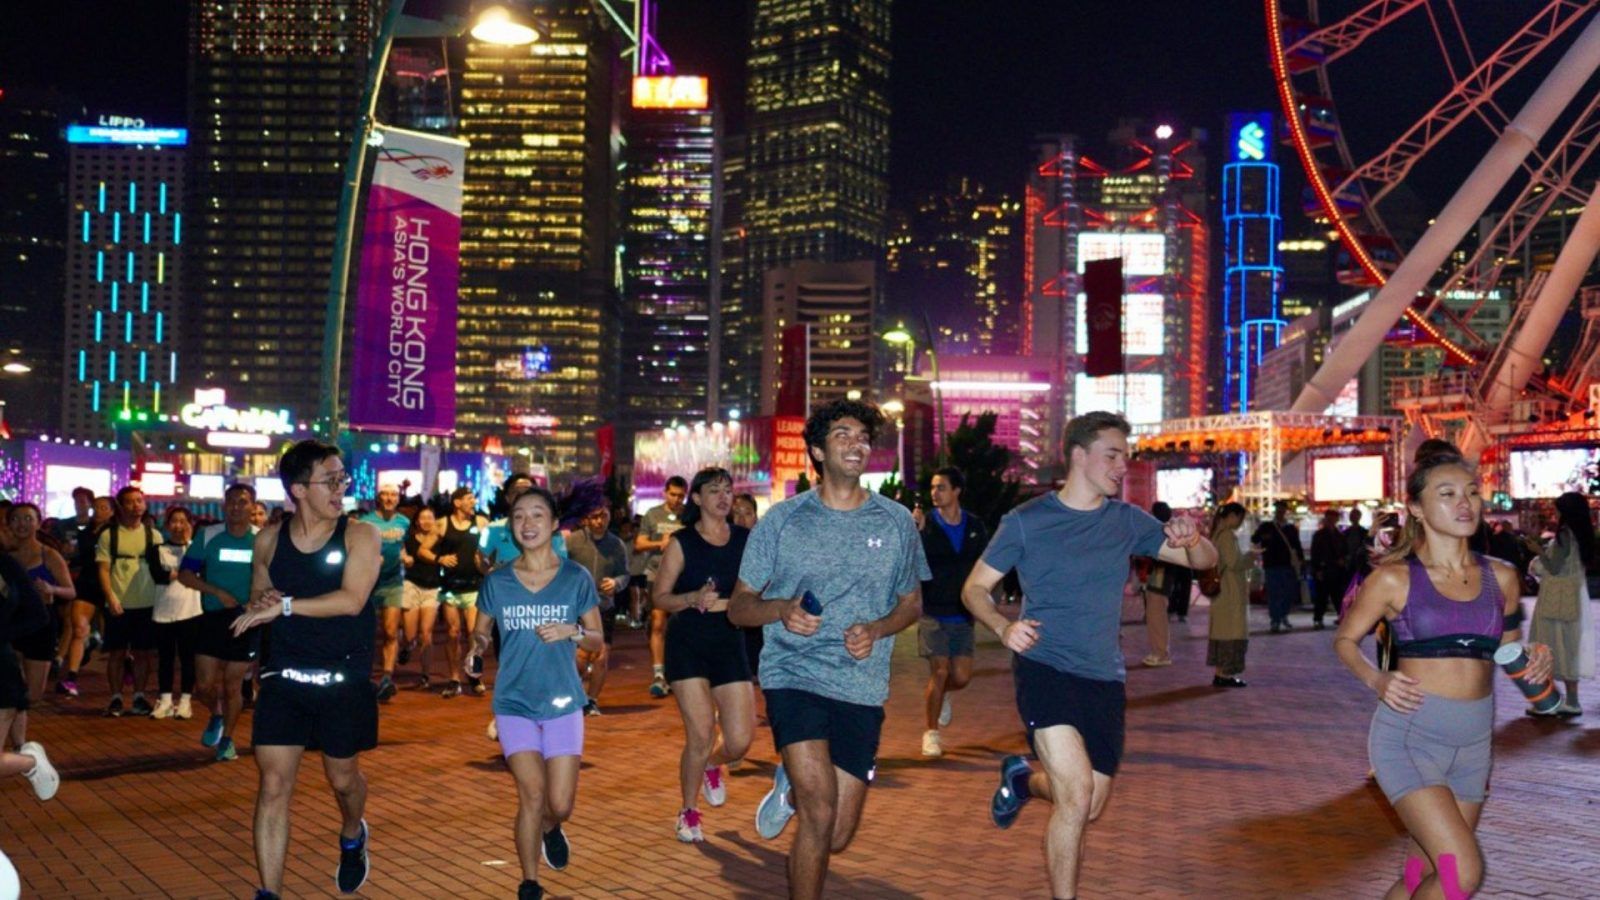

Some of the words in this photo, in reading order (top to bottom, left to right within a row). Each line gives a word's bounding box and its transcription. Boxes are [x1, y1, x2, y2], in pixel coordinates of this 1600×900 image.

[99, 115, 145, 128] LIPPO
[393, 216, 408, 280] ASIA'S
[407, 218, 430, 311] HONG
[390, 285, 404, 356] WORLD
[387, 360, 401, 407] CITY
[403, 316, 426, 410] KONG
[502, 604, 569, 618] MIDNIGHT
